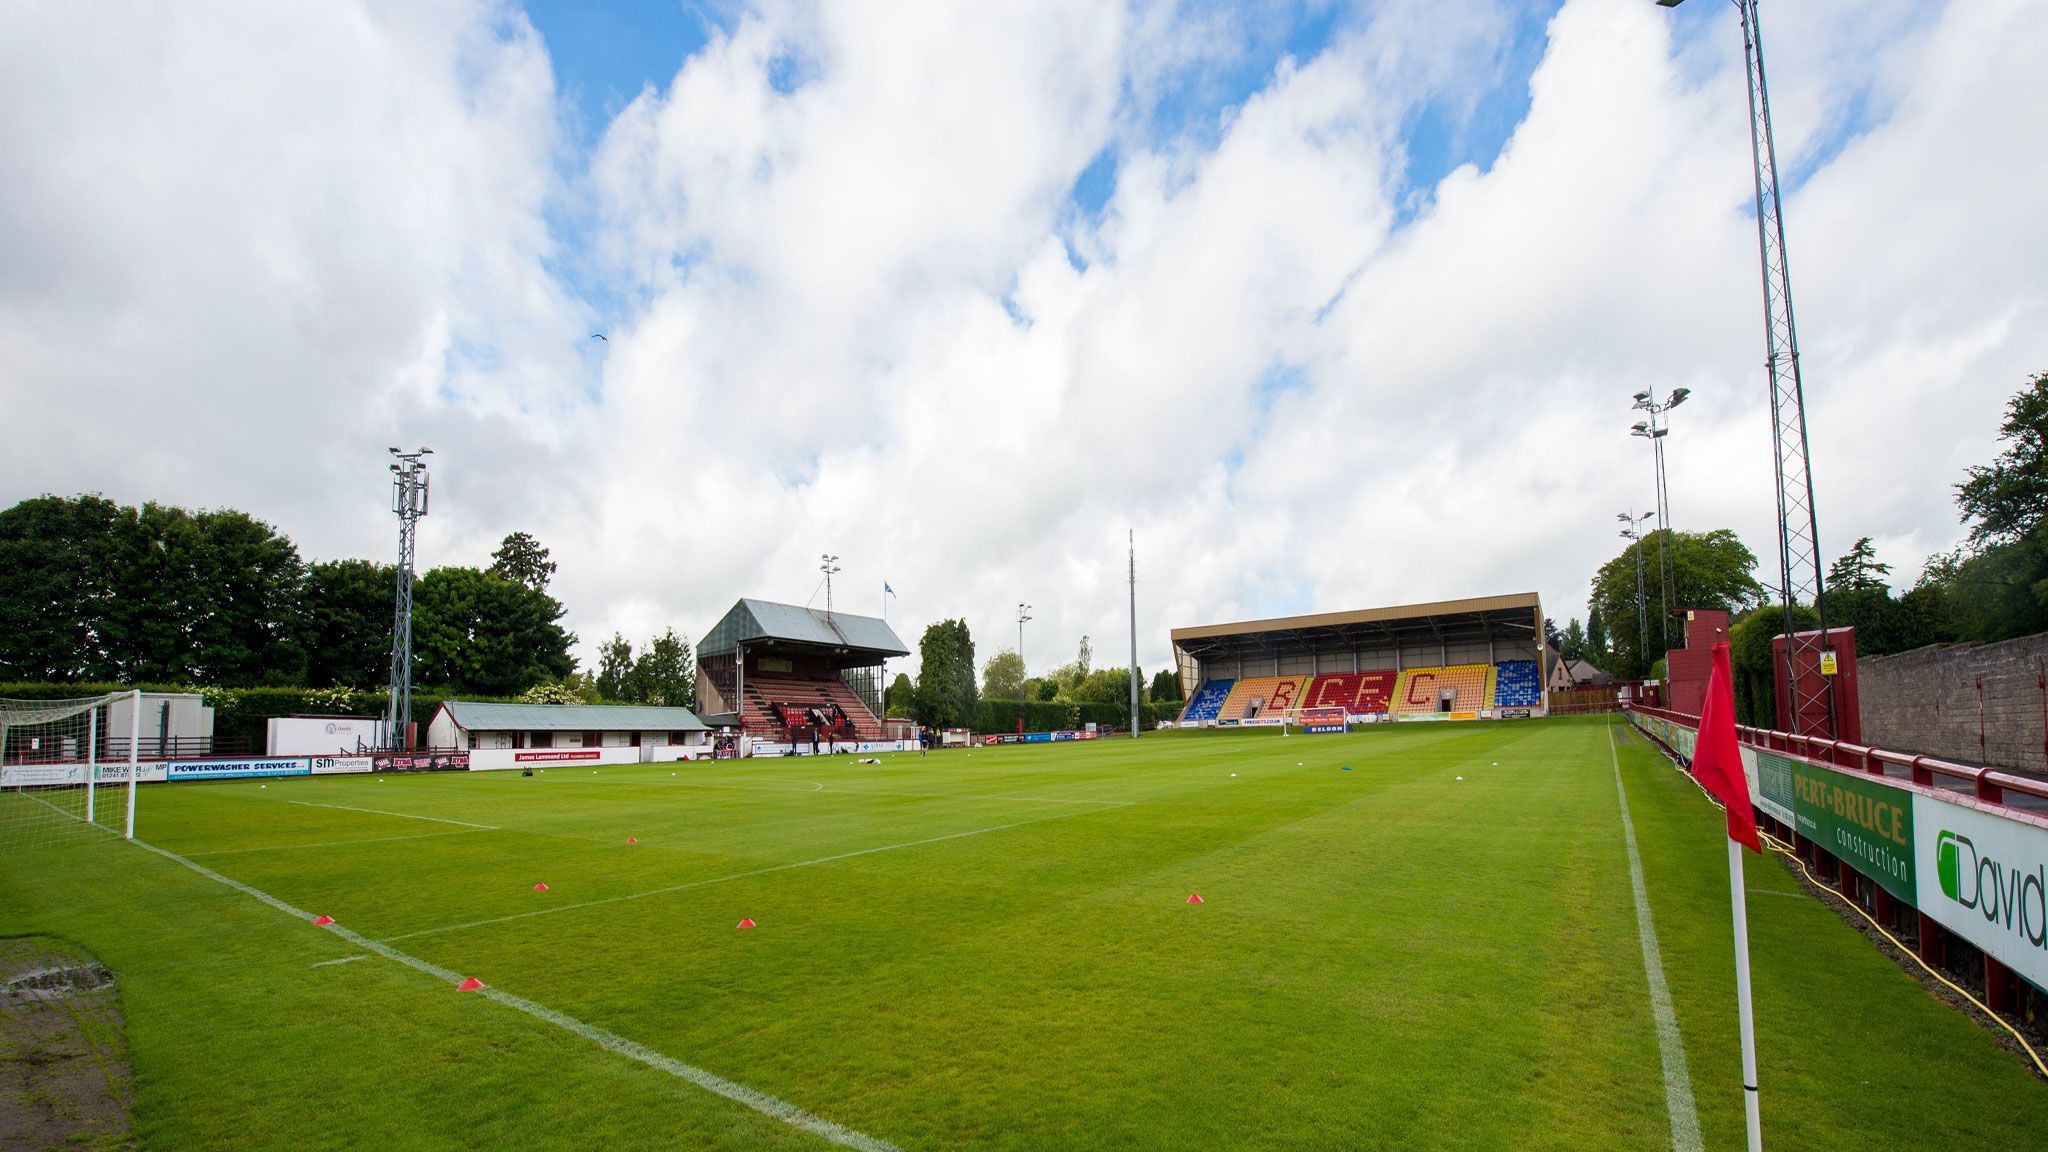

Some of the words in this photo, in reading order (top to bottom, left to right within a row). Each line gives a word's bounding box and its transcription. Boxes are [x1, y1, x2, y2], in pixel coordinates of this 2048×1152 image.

[174, 763, 250, 772] POWERWASHER
[334, 759, 368, 767] Properties
[1794, 774, 1906, 845] PERT-BRUCE
[1837, 827, 1907, 882] construction
[1956, 834, 2048, 950] David
